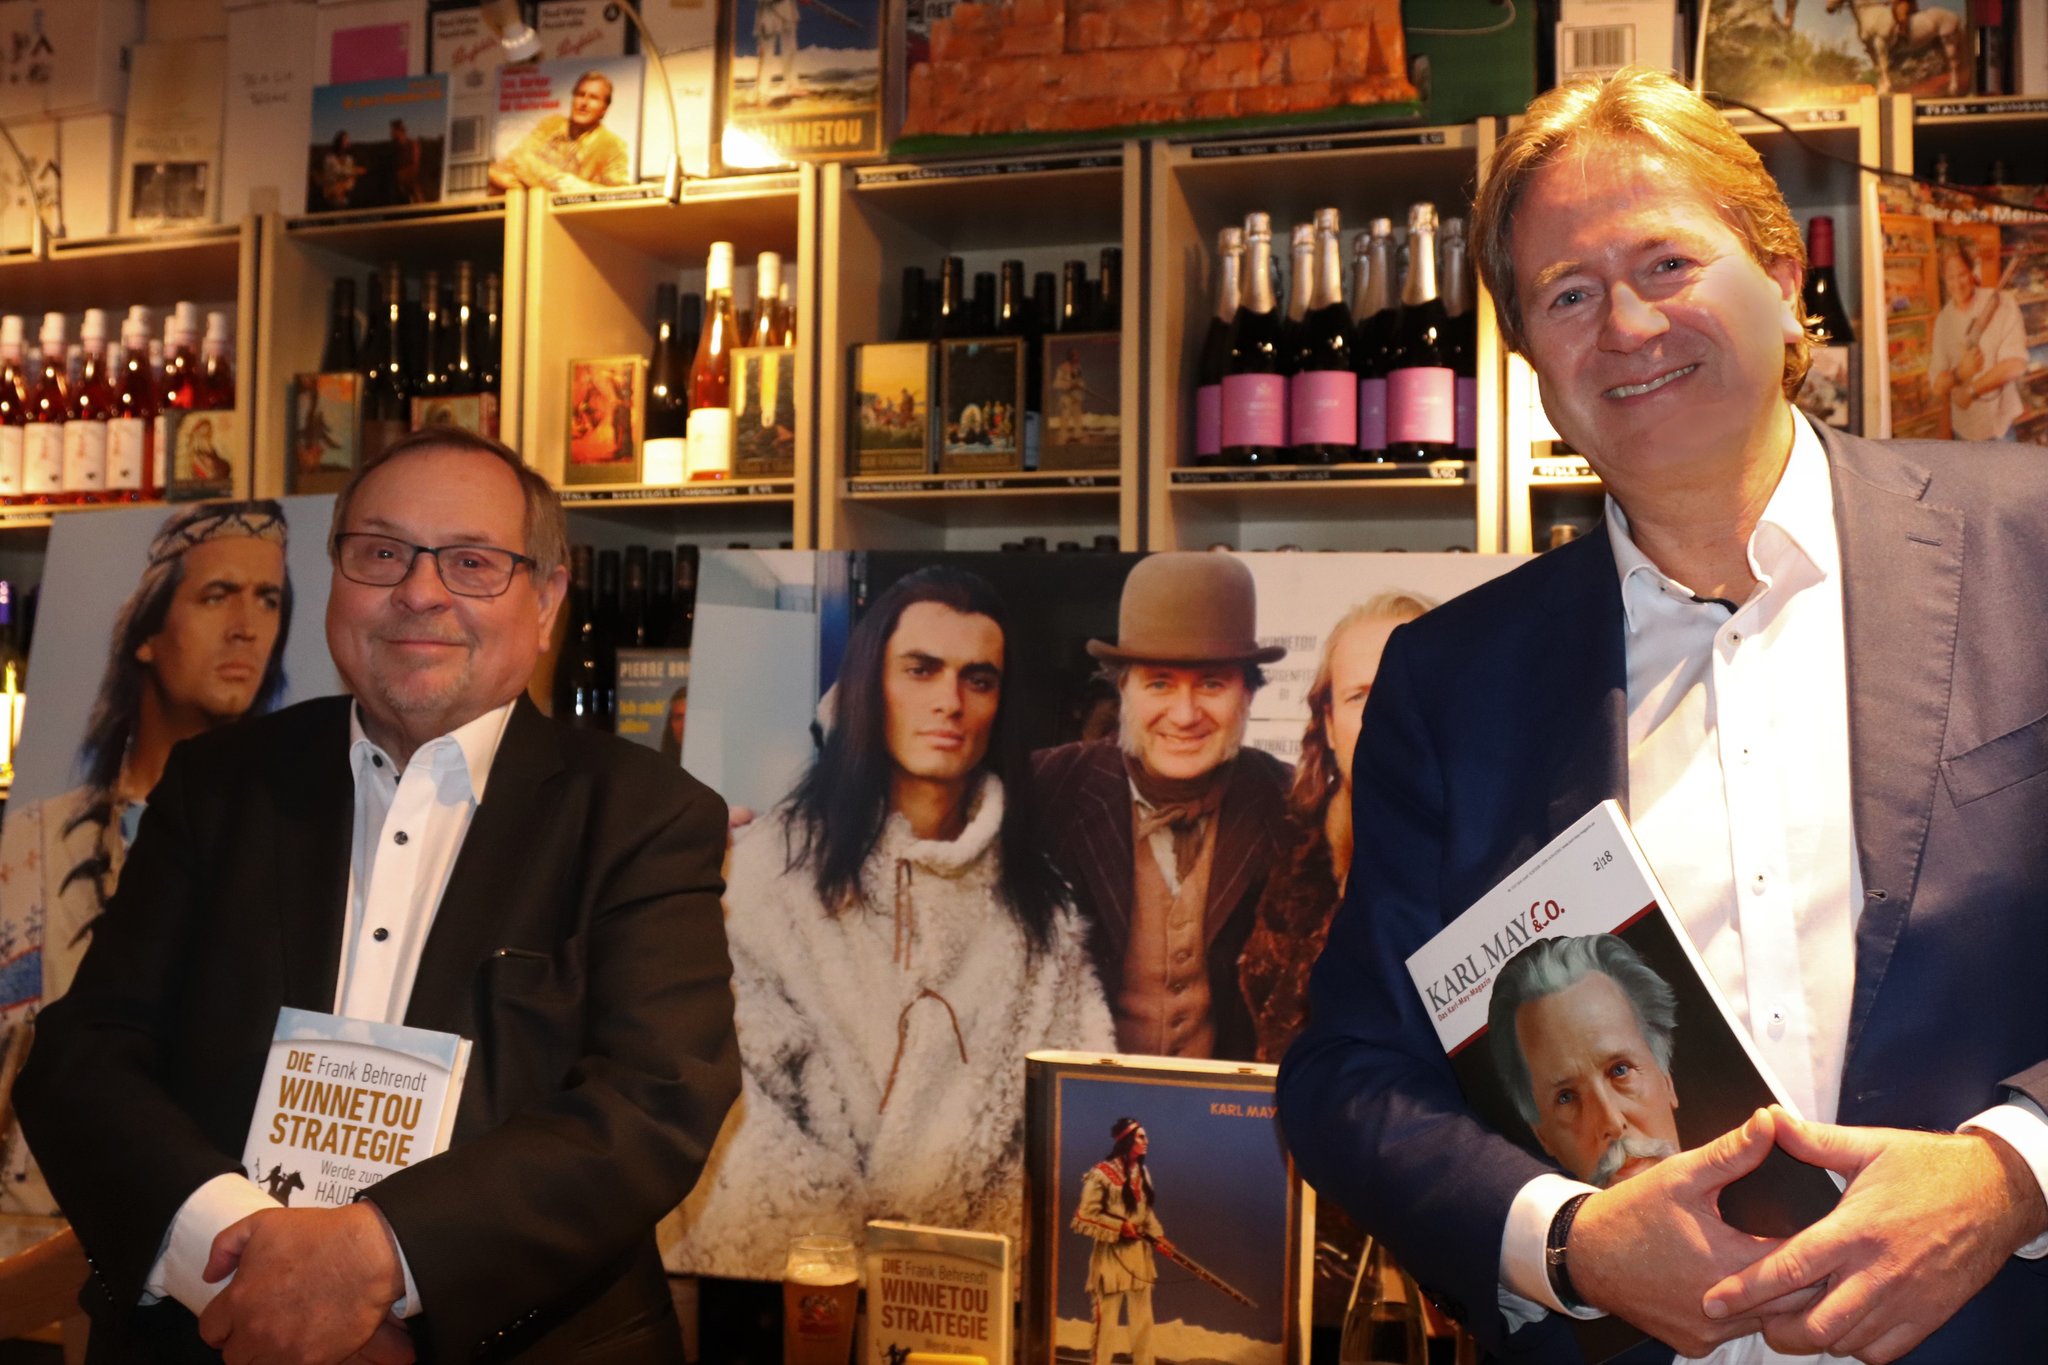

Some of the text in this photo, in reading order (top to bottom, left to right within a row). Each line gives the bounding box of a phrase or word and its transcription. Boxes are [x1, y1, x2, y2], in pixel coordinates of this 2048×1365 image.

[620, 661, 664, 678] PIERRE
[1425, 954, 1487, 1013] KARL
[1480, 911, 1532, 970] MAY
[1437, 1010, 1449, 1022] Das
[286, 1050, 427, 1092] DIE Frank Behrendt
[278, 1075, 423, 1130] WINNETOU
[1210, 1103, 1278, 1119] KARL MAY
[269, 1112, 414, 1167] STRATEGIE
[321, 1159, 384, 1184] Werde zum
[315, 1180, 366, 1206] HÄUP
[881, 1258, 988, 1286] DIE Frank Behrendt
[880, 1277, 988, 1314] WINNETOU
[881, 1305, 988, 1341] STRATEGIE
